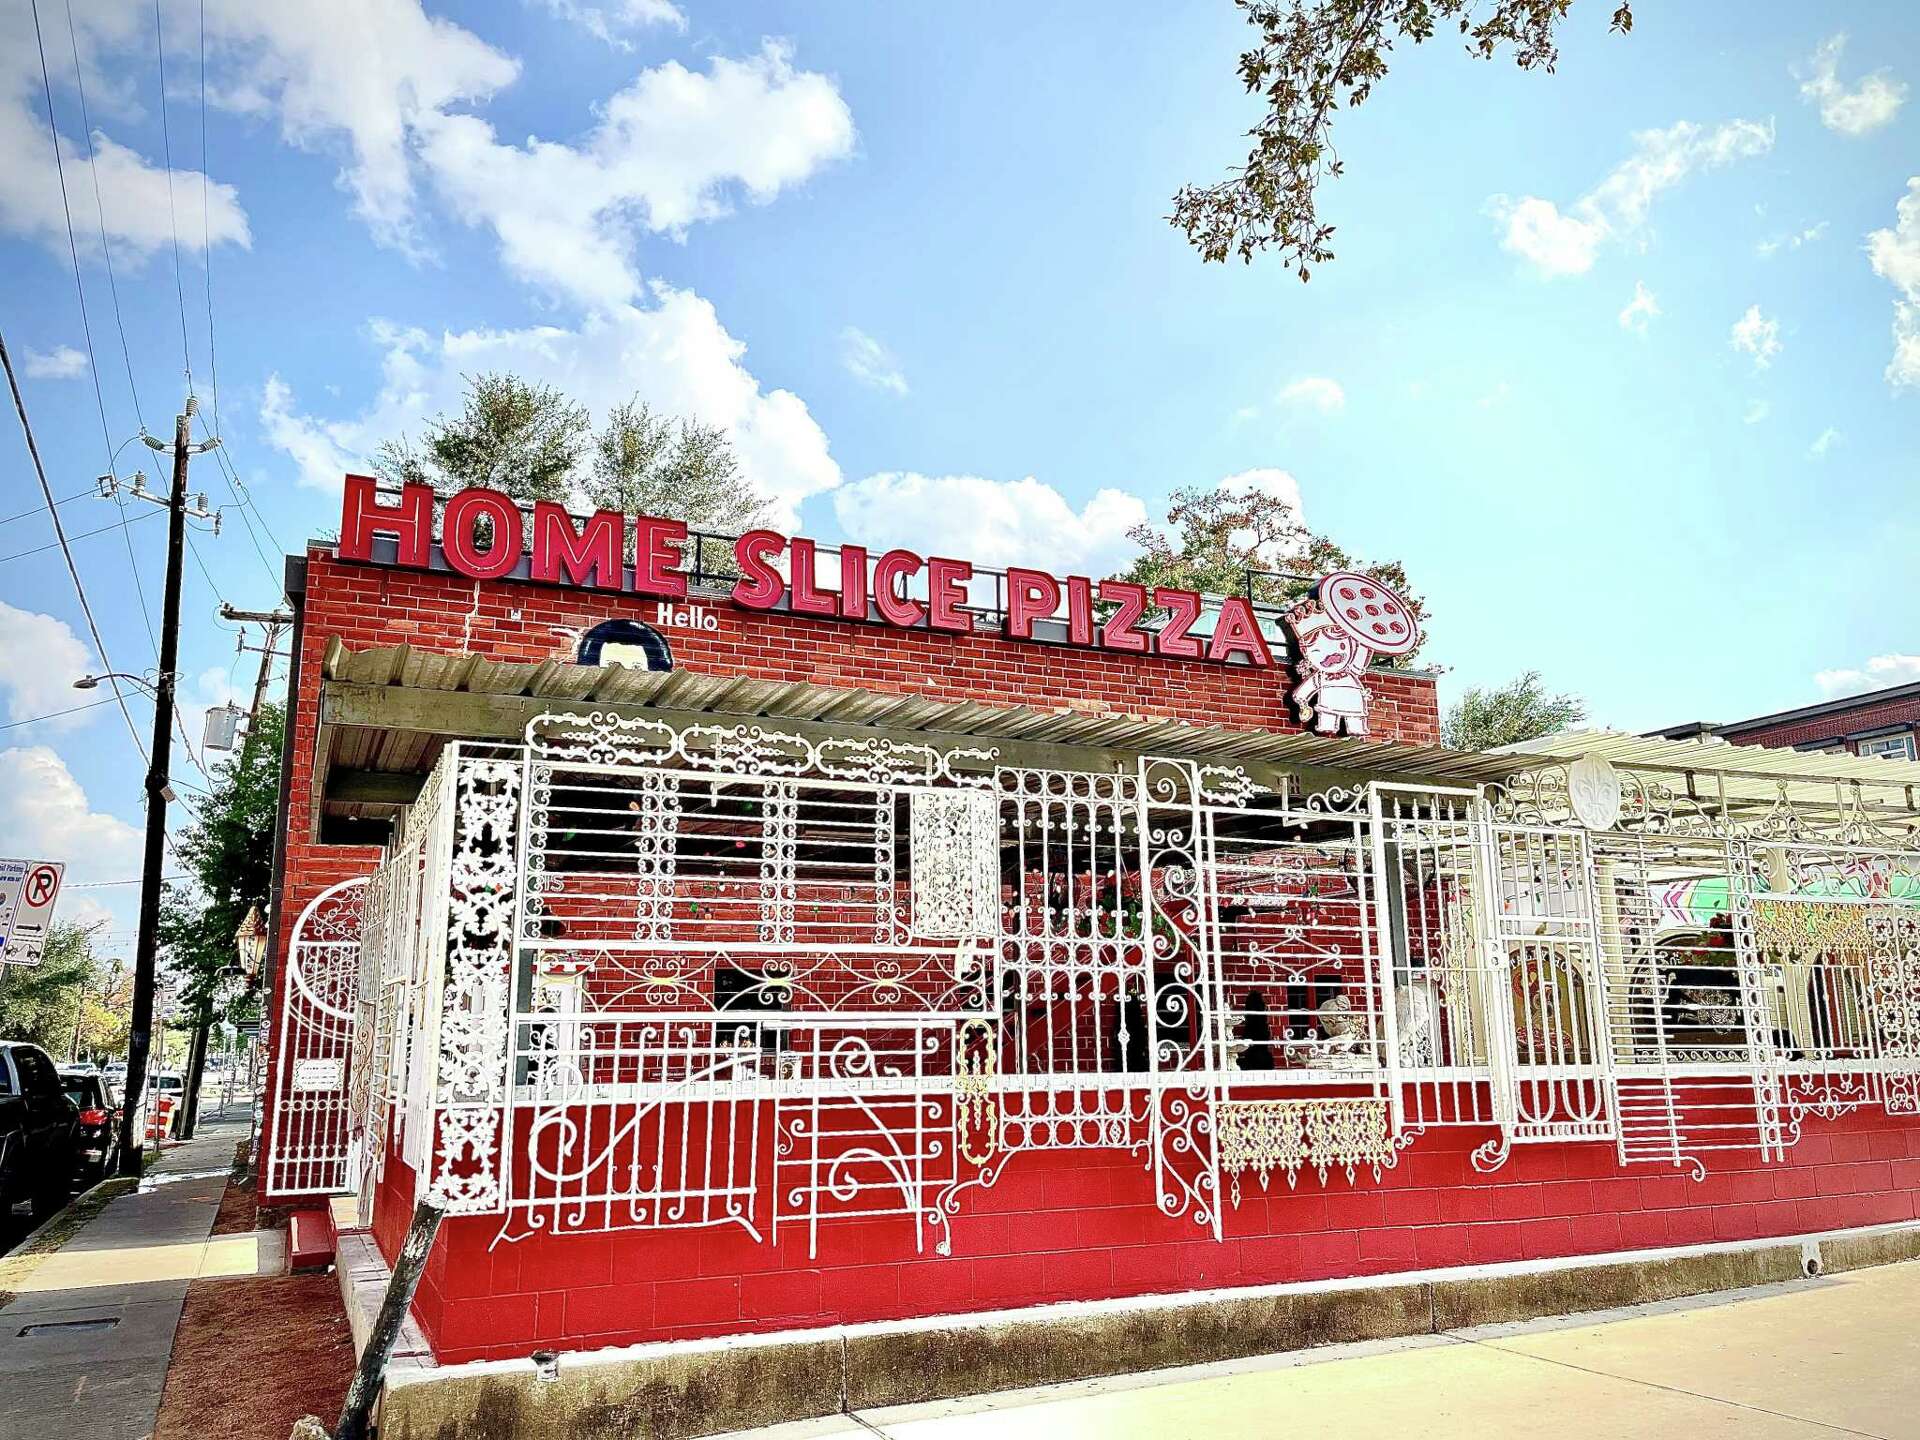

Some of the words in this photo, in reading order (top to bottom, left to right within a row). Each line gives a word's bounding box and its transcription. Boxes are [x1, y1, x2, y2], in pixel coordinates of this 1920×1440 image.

[339, 474, 688, 597] HOME
[731, 530, 974, 635] SLICE
[1003, 567, 1275, 668] PIZZA
[657, 602, 718, 631] Hello
